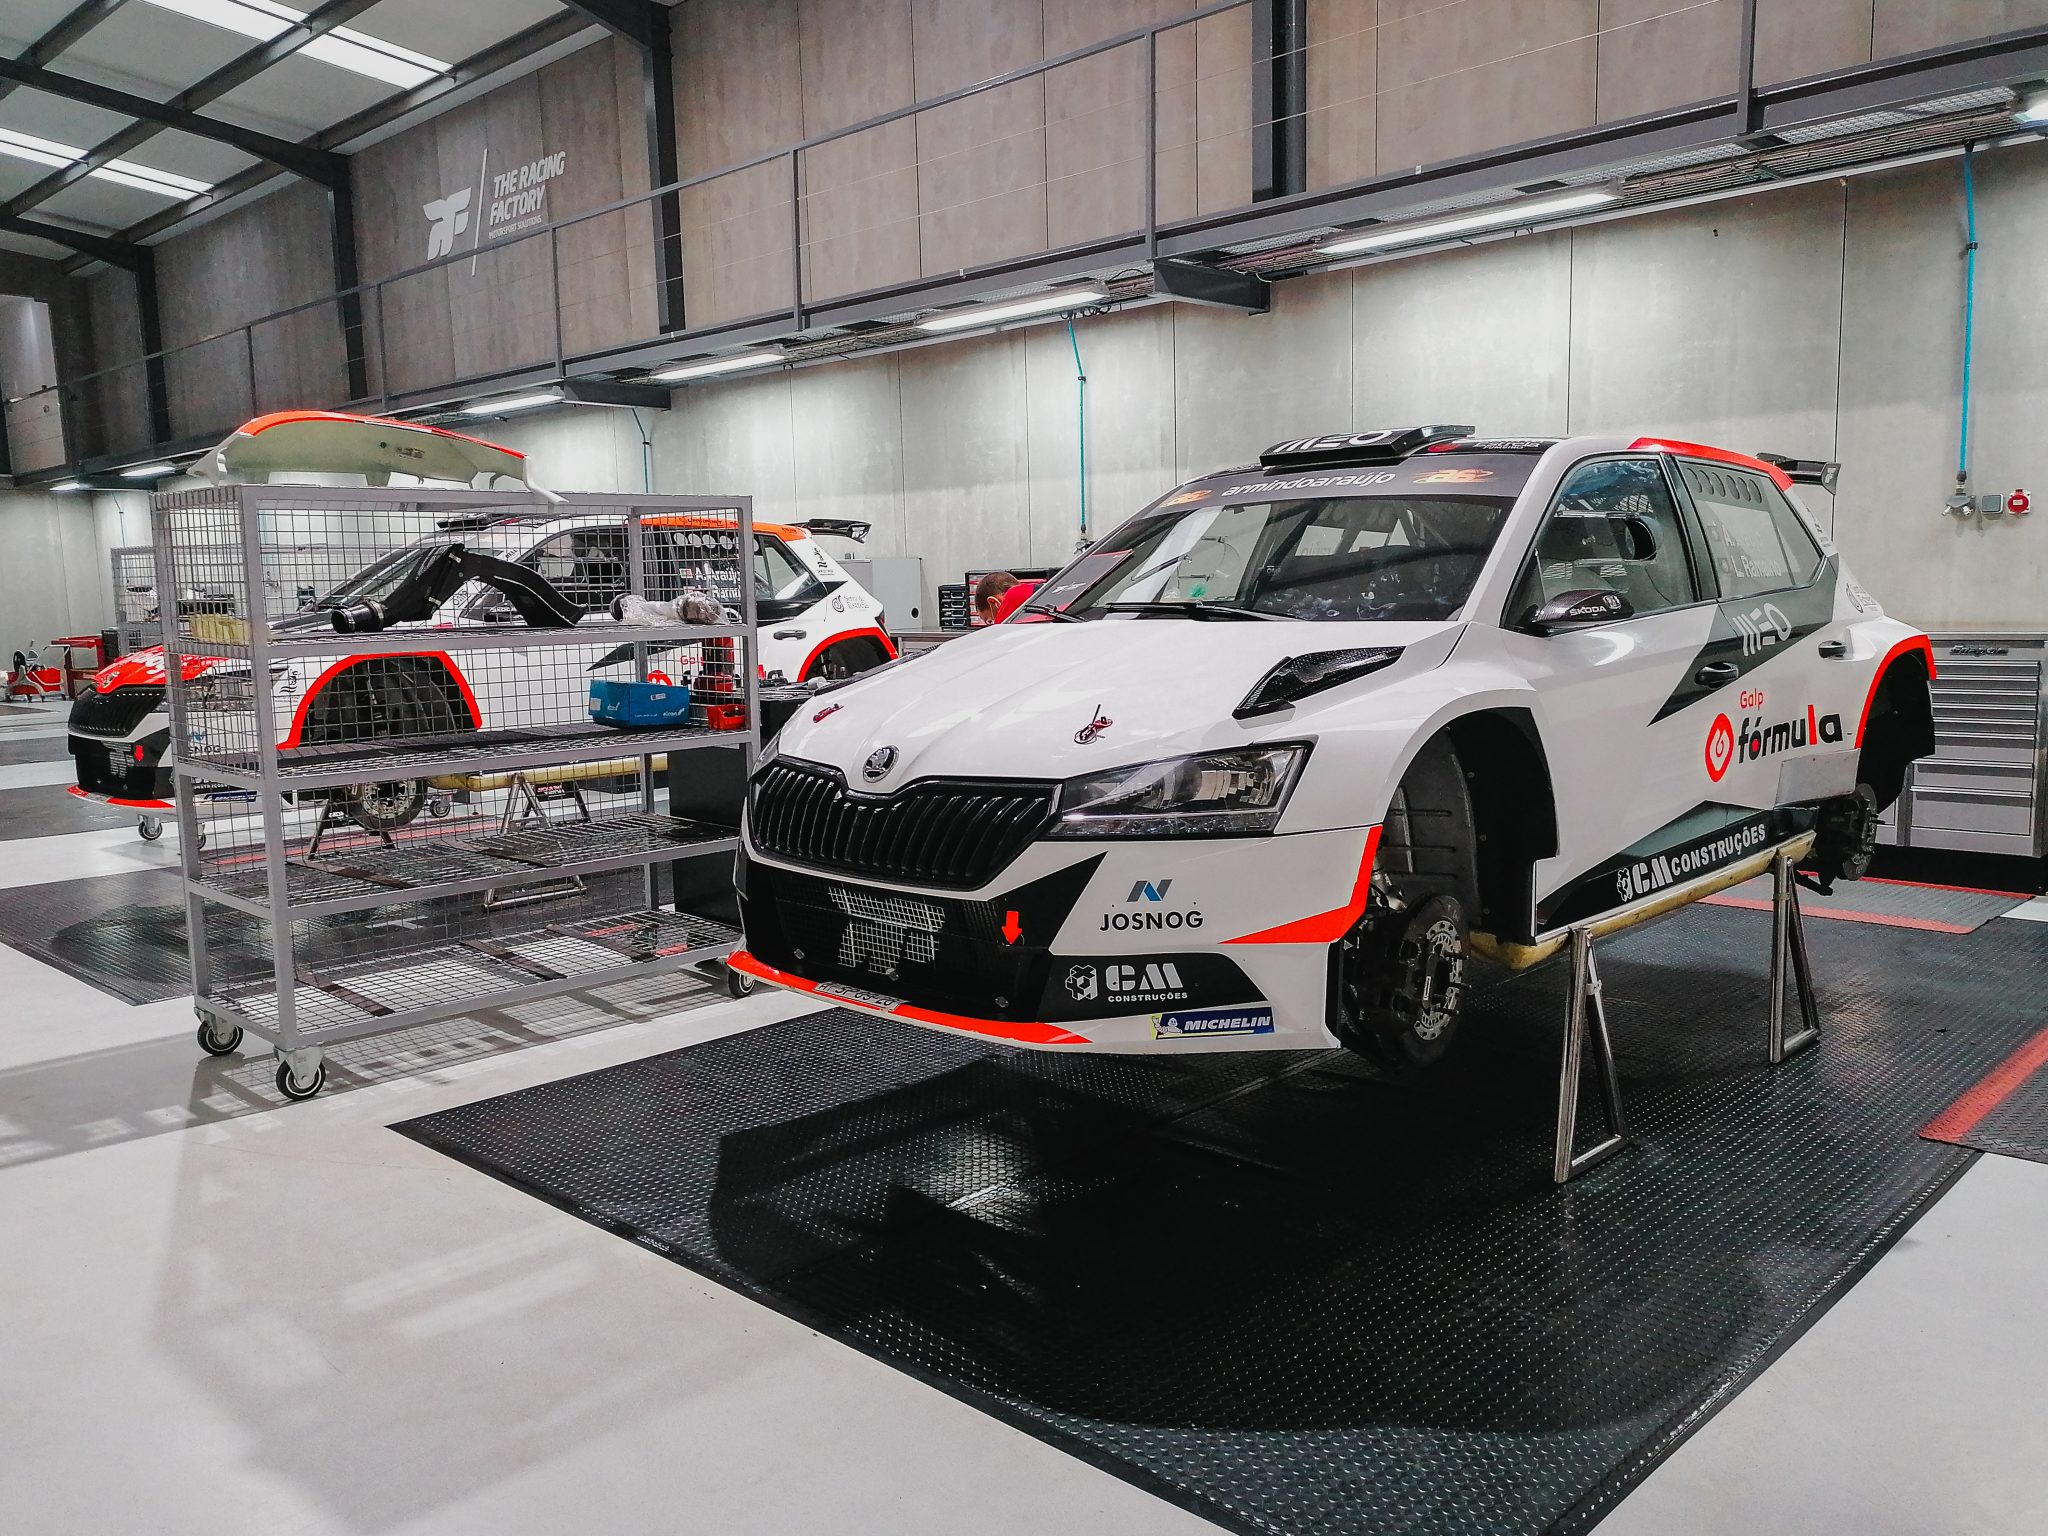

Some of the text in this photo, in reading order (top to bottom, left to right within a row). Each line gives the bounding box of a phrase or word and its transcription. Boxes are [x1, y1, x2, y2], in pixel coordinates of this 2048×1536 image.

[494, 151, 566, 198] THE RACING
[490, 185, 545, 225] FACTORY
[1221, 472, 1396, 497] armindoaraújo
[1732, 603, 1792, 656] MEO
[1740, 688, 1763, 710] Galp
[1738, 704, 1843, 764] fórmula
[1671, 823, 1766, 876] CONSTRUÇÕES
[1100, 911, 1204, 931] JOSNOG
[1108, 991, 1189, 1003] CONSTRUÇÕES
[1184, 1016, 1272, 1031] MICHELIN
